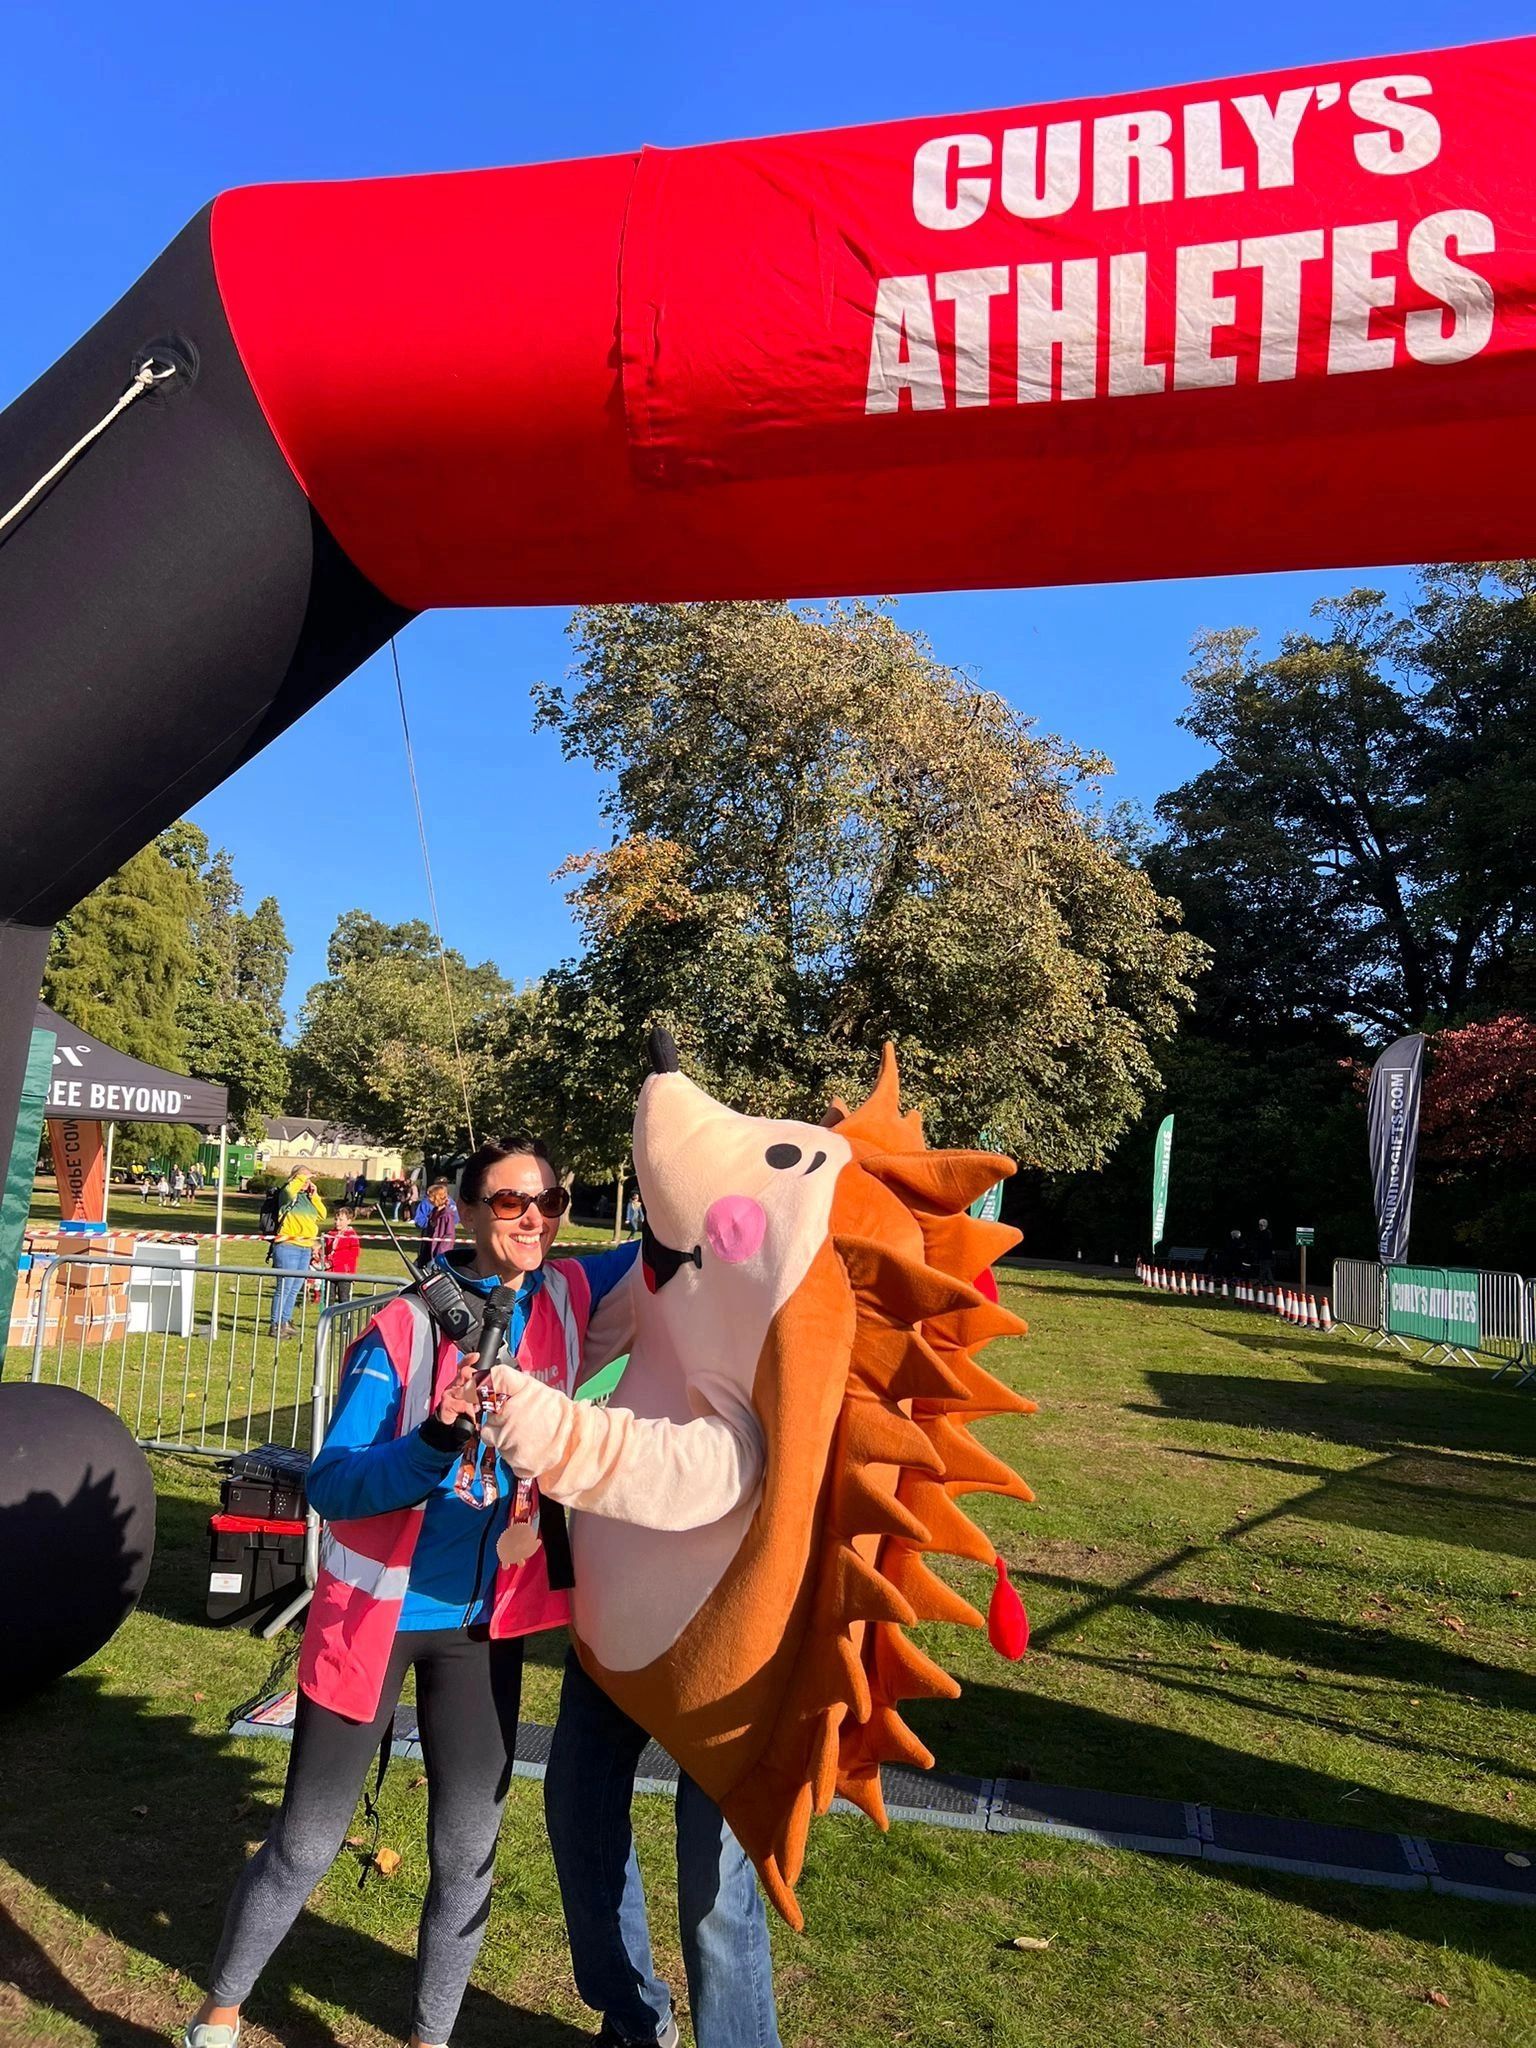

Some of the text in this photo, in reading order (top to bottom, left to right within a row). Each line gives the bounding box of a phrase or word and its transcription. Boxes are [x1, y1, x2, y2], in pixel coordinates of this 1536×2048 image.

[912, 74, 1442, 231] CURLY'S
[864, 209, 1496, 415] ATHLETES
[1391, 1282, 1476, 1324] CURLY'S ATHLETES
